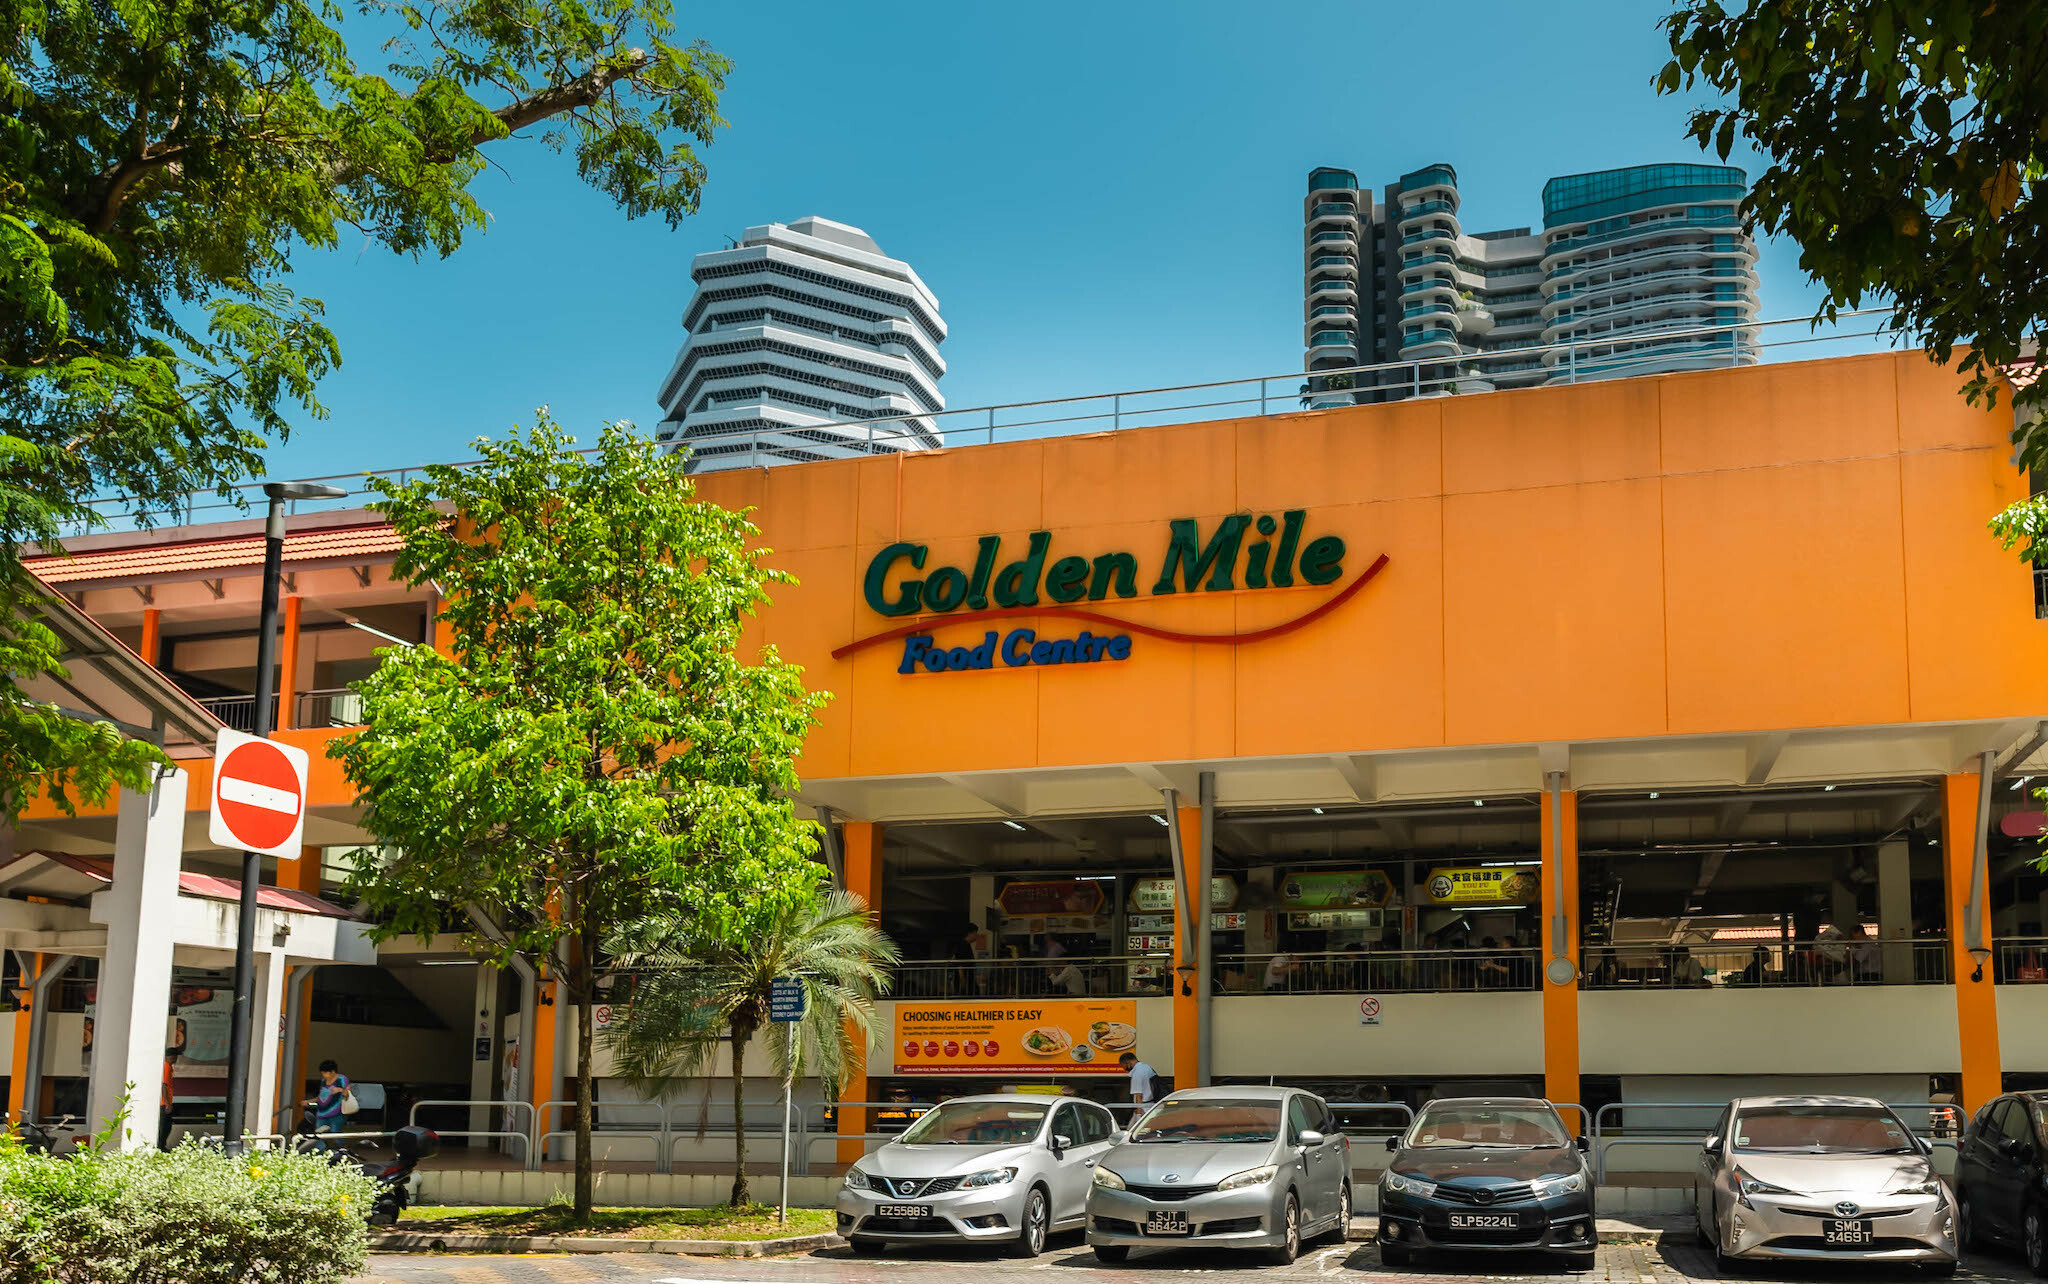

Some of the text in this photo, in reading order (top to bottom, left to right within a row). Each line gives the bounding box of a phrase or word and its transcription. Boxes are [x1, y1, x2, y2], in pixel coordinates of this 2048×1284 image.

[864, 510, 1346, 616] Golden Mile
[898, 628, 1132, 673] Food Centre
[1129, 937, 1141, 949] 59
[903, 1010, 1042, 1021] CHOOSING HEALTHIER IS EASY
[880, 1206, 928, 1217] EZ5588S
[1156, 1211, 1178, 1221] SJT
[1148, 1221, 1186, 1231] 9642P
[1451, 1216, 1517, 1227] SLP5224L
[1834, 1221, 1861, 1231] SMQ
[1826, 1231, 1871, 1242] 3469T
